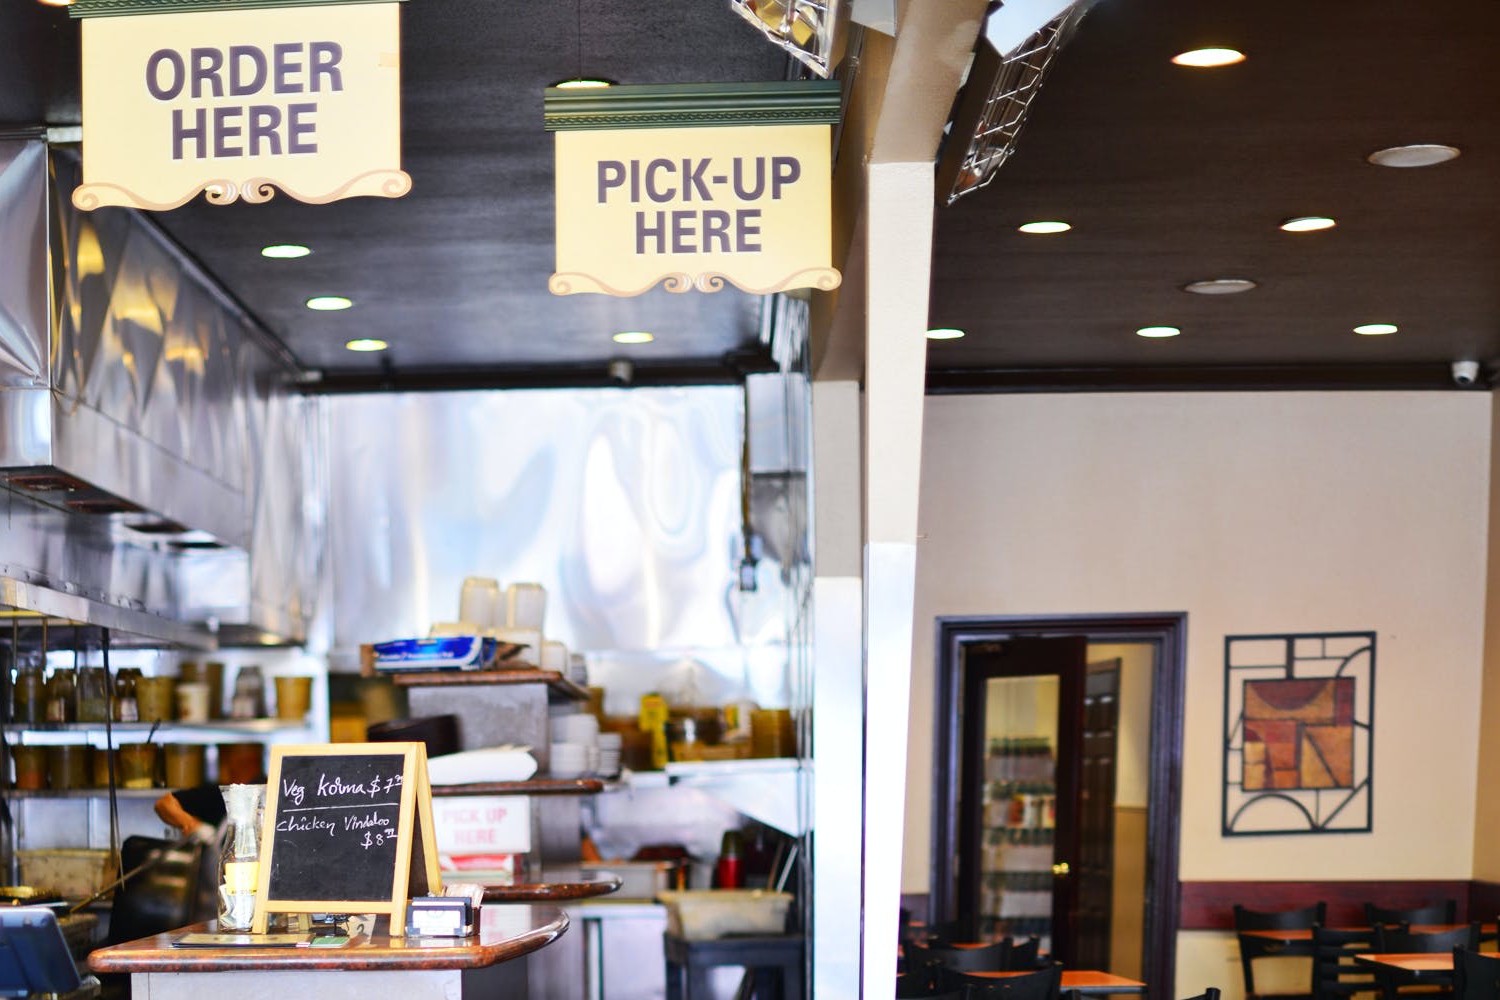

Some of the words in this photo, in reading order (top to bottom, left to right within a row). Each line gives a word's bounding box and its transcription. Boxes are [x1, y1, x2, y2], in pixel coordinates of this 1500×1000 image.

[147, 42, 341, 100] ORDER
[173, 104, 316, 159] HERE
[599, 157, 800, 202] PICK-UP
[637, 210, 761, 253] HERE
[283, 778, 305, 806] Veg
[485, 807, 508, 824] UP
